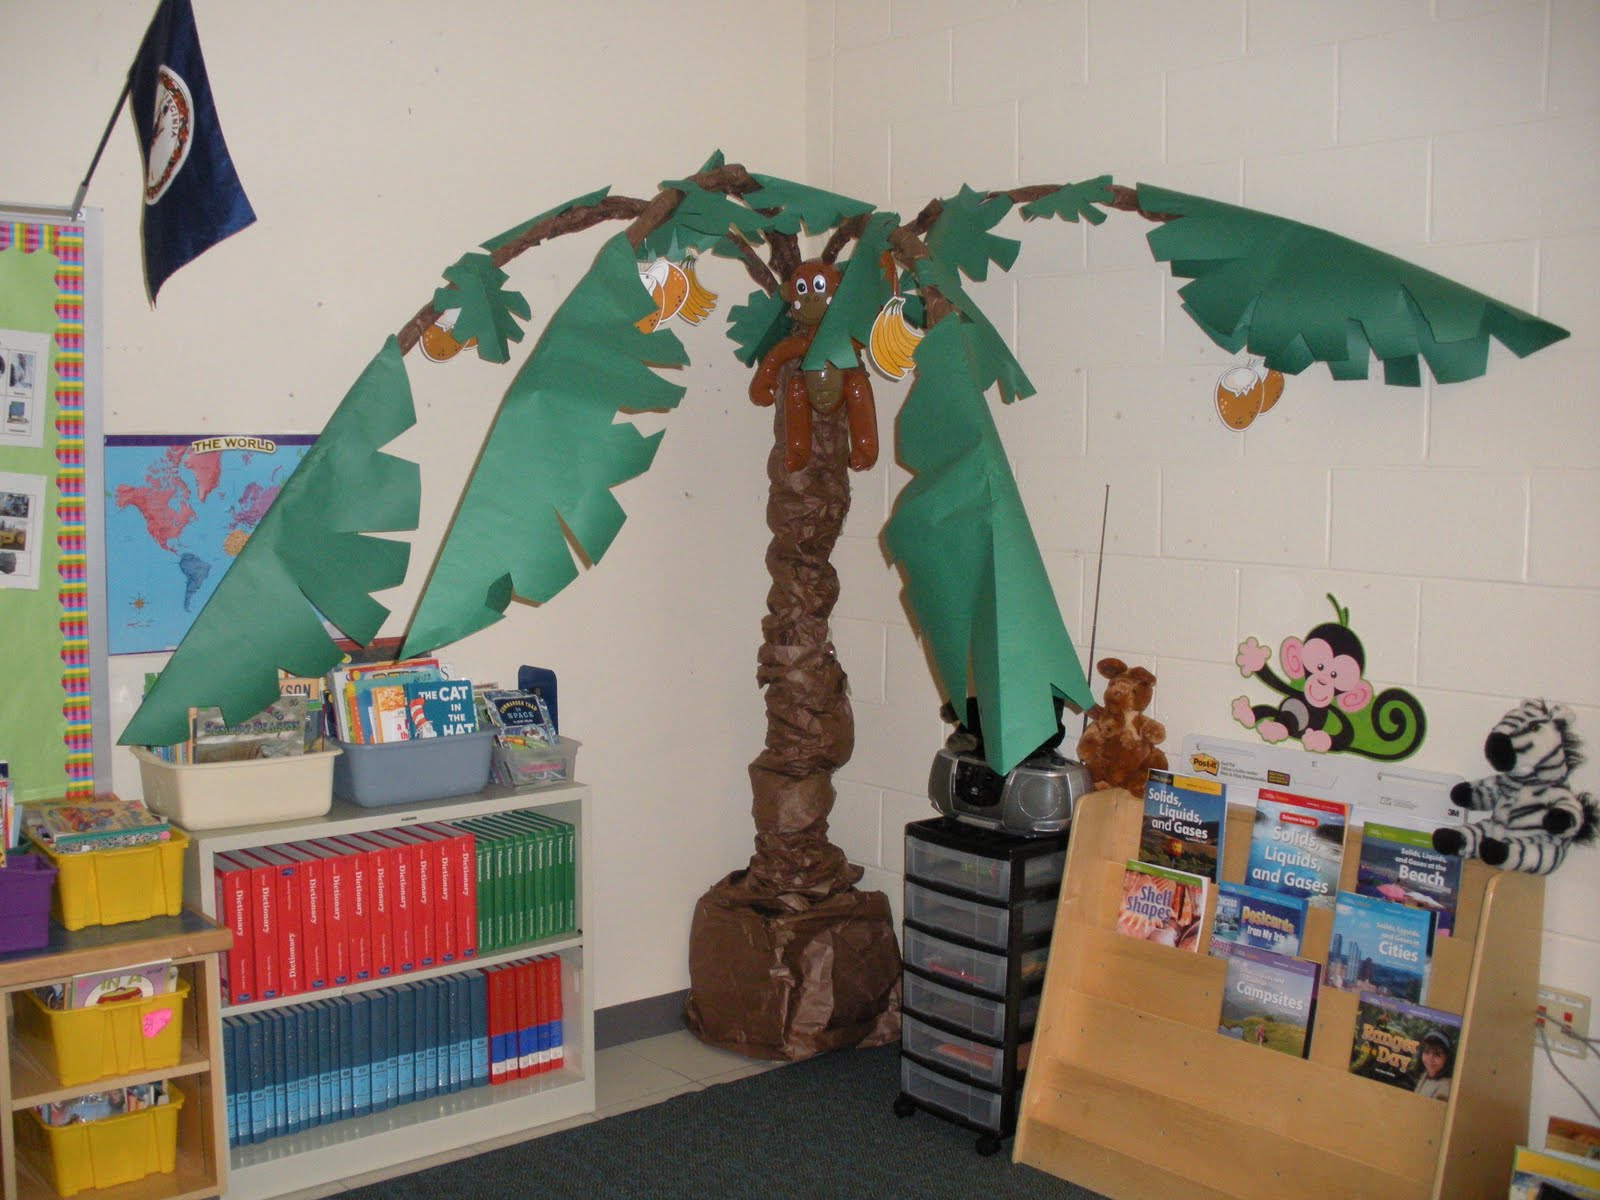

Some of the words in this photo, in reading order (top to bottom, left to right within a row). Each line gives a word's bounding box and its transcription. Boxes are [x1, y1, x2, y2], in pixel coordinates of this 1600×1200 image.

[193, 439, 221, 452] THE
[224, 438, 274, 452] WORLD
[418, 690, 438, 700] THE
[439, 686, 469, 702] CAT
[448, 713, 466, 722] THE
[451, 703, 461, 711] IN
[499, 700, 525, 714] COMMANDER
[507, 711, 535, 719] SPACE
[442, 723, 474, 736] HAT
[1193, 758, 1217, 769] Post-it
[1148, 787, 1182, 808] Solids,
[1159, 803, 1203, 826] Liquids,
[1282, 814, 1299, 822] Science
[1299, 817, 1315, 825] Inquiry
[1447, 808, 1460, 817] 3M
[1151, 818, 1172, 831] and
[1174, 822, 1208, 839] Gases
[1272, 826, 1320, 852] Solids,
[1264, 846, 1322, 872] Liquids,
[1401, 848, 1421, 858] Solids,
[1395, 856, 1407, 864] and
[1408, 858, 1427, 868] Gases
[1435, 864, 1447, 872] the
[441, 857, 449, 901] Dictionary
[1252, 868, 1281, 883] and
[1284, 872, 1329, 893] Gases
[1398, 865, 1445, 887] Beach
[355, 871, 363, 917] Dictionary
[377, 868, 385, 913] Dictionary
[1140, 885, 1172, 907] Shell
[262, 887, 270, 934] Dictionary
[309, 878, 317, 925] Dictionary
[1126, 896, 1171, 920] Shapes
[236, 890, 244, 937] Dictionary
[1241, 905, 1294, 935] Postcards
[1247, 925, 1262, 938] from
[1262, 929, 1273, 941] My
[1273, 932, 1285, 944] Trip
[1379, 941, 1418, 962] Cities
[100, 977, 120, 991] IN
[127, 974, 142, 985] A
[1236, 981, 1304, 1010] Campsites
[1361, 1023, 1420, 1054] Ranger
[1376, 1045, 1411, 1073] Day
